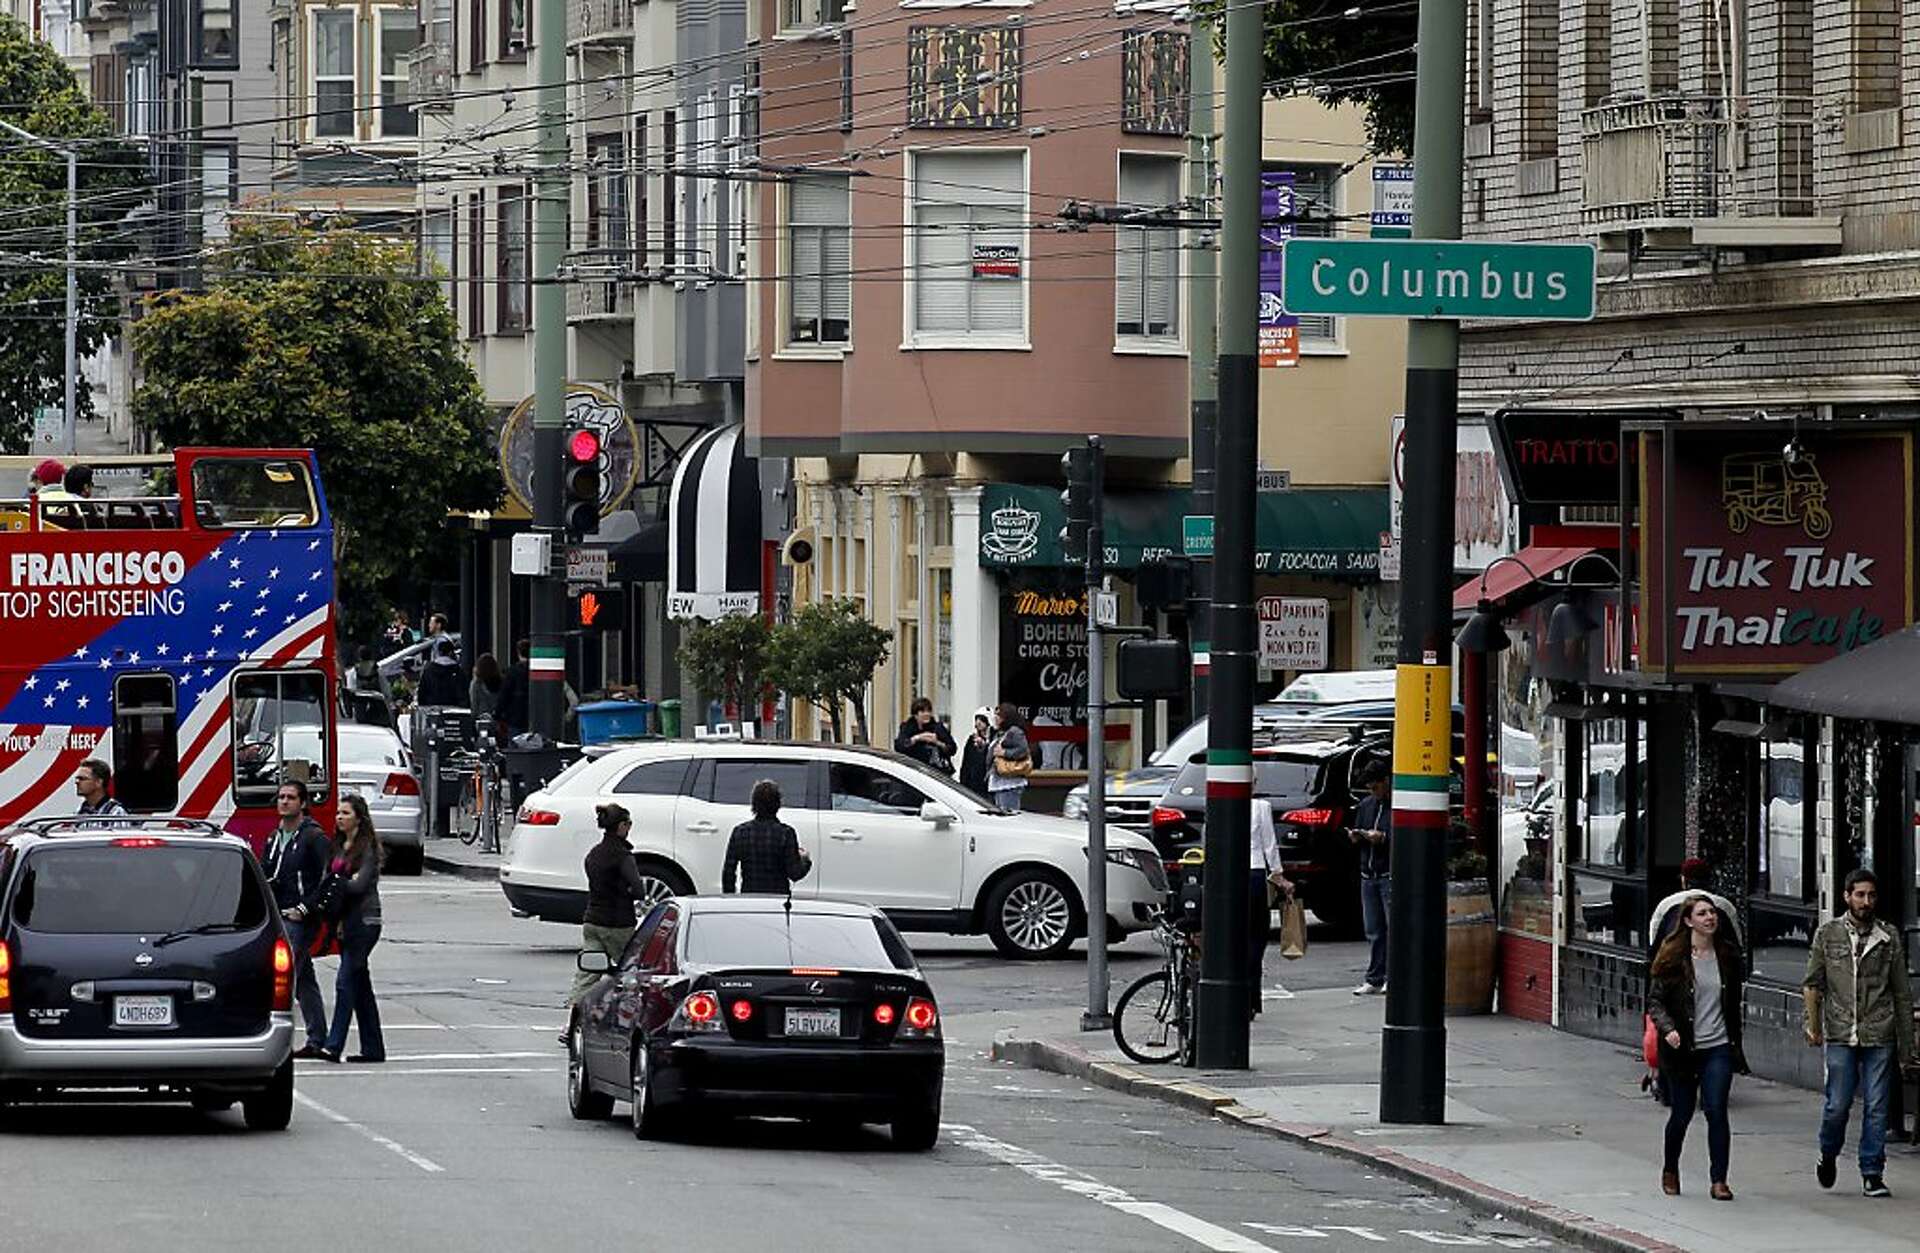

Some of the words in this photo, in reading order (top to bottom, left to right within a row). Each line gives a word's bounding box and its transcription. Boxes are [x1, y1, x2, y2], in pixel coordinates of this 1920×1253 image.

[1312, 258, 1567, 300] Columbus
[11, 551, 185, 586] FRANCISCO
[1279, 553, 1338, 569] FOCACCIA
[1347, 553, 1380, 569] SAND
[1683, 547, 1774, 592] Tuk
[1784, 547, 1875, 592] Tuk
[48, 589, 185, 618] SIGHTSEEING
[719, 598, 749, 607] HAIR
[1262, 600, 1280, 618] NO
[1282, 604, 1325, 619] PARKING
[1019, 644, 1060, 658] CIGAR
[1267, 641, 1284, 653] MON
[1287, 641, 1304, 654] WED
[1040, 662, 1088, 697] Cafe
[3, 735, 31, 752] YOUR
[71, 733, 97, 750] HERE
